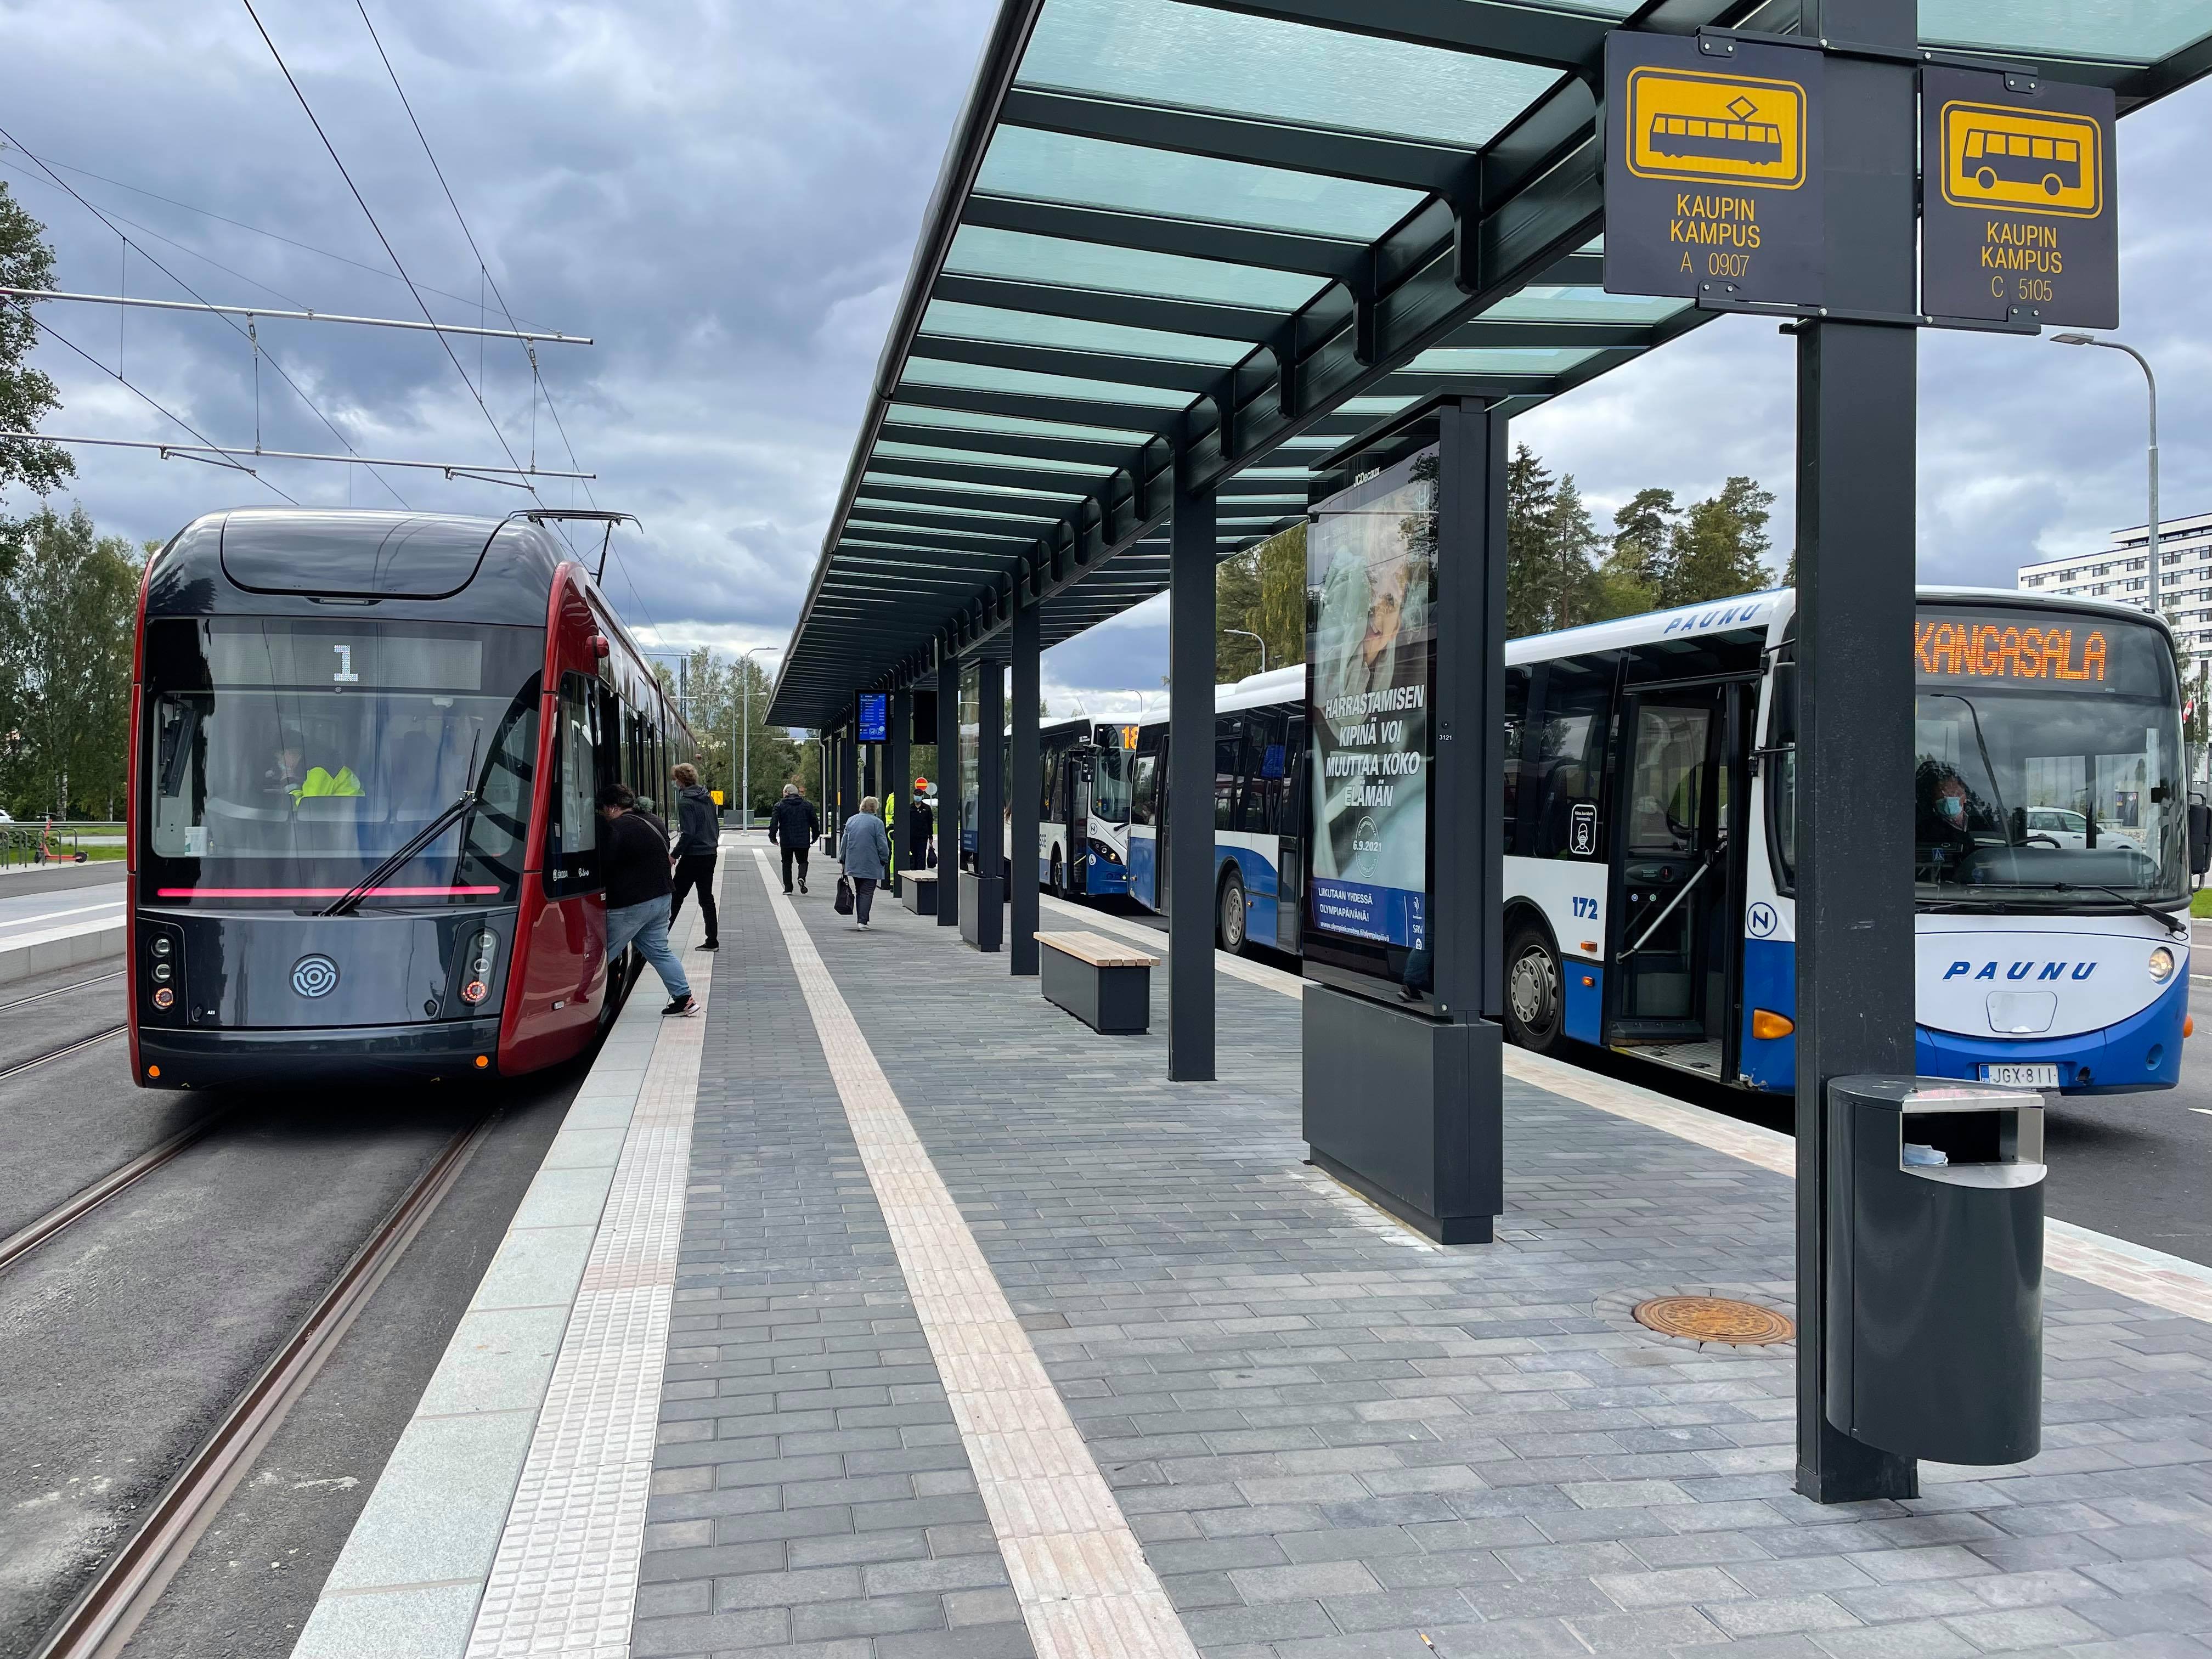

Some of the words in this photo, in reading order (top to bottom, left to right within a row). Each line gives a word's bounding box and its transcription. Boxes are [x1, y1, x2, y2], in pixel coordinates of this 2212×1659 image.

[1677, 193, 1755, 222] KAUPIN
[1670, 219, 1761, 249] KAMPUS
[1987, 221, 2057, 249] KAUPIN
[1680, 251, 1694, 273] A
[1708, 252, 1751, 277] 0907
[1981, 245, 2063, 274] KAMPUS
[1991, 275, 2004, 298] C
[2018, 278, 2053, 302] 5105
[1353, 466, 1380, 487] JCDecaux
[1663, 603, 1763, 634] PAUNU
[334, 645, 358, 681] 1
[1915, 622, 2107, 681] KANGASALA
[1325, 684, 1425, 720] HARRASTAMISEN
[1339, 716, 1378, 747] KIPINÄ
[1381, 720, 1403, 744] VOI
[1325, 754, 1380, 778] MUUTTAA
[1382, 751, 1421, 776] KOKO
[1344, 778, 1395, 808] ELÄMÄN
[1352, 839, 1383, 853] 6.9.2021
[1318, 887, 1346, 901] LIIKUTAAN
[1347, 891, 1374, 906] YHDESSÄ
[1572, 896, 1598, 920] 172
[1319, 904, 1370, 923] OLYMPIAPÄIVÄNÄ!
[1412, 923, 1424, 935] SRV
[1941, 961, 2099, 981] PAUNU
[1993, 1067, 2052, 1084] JGX-811
